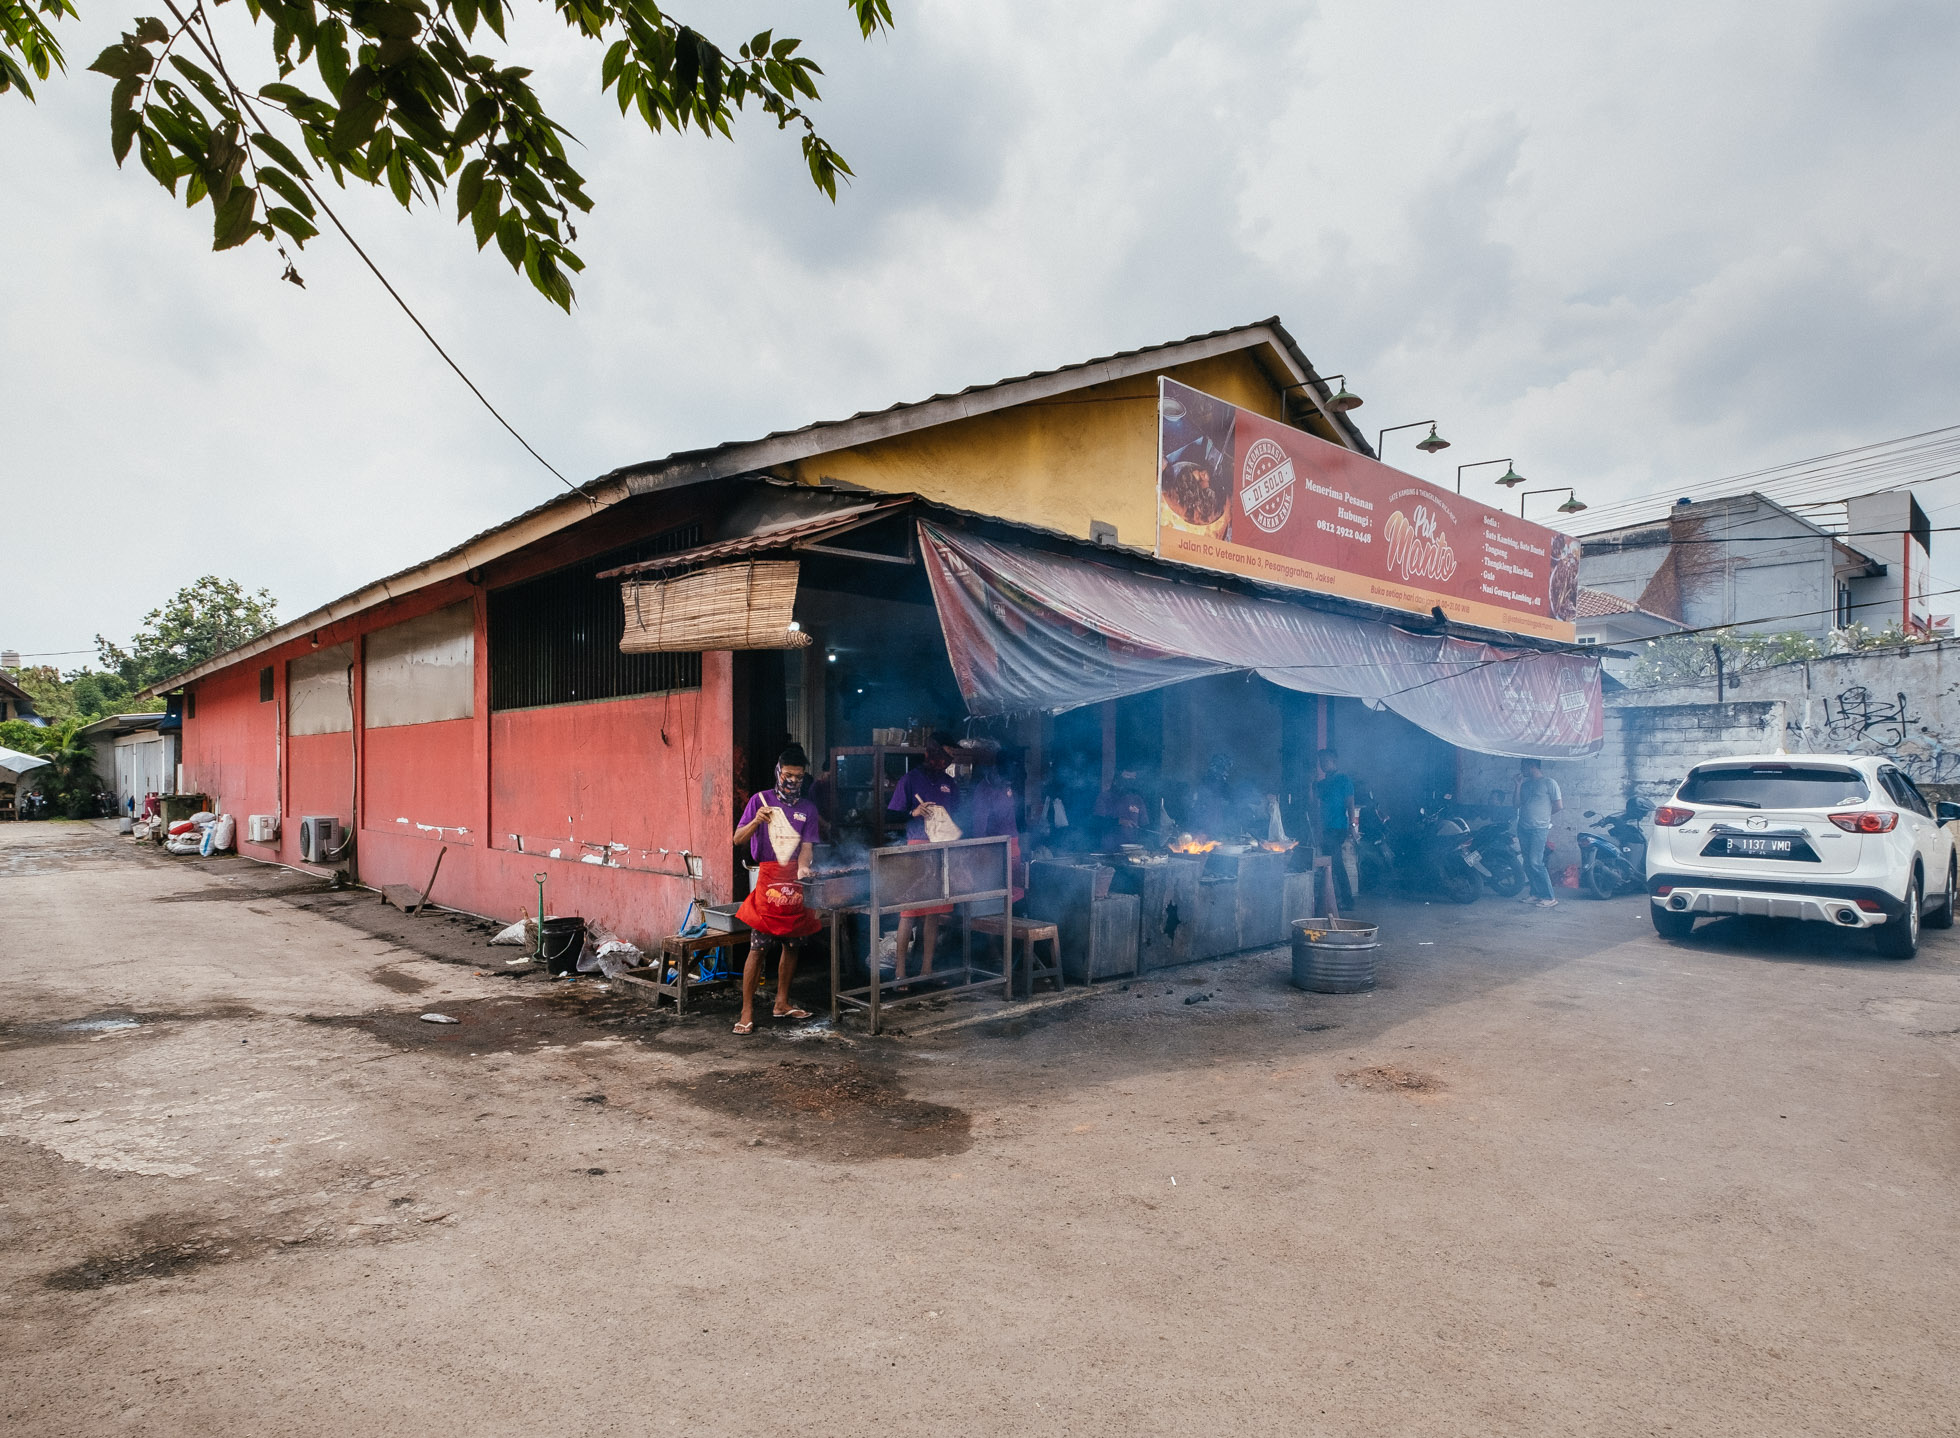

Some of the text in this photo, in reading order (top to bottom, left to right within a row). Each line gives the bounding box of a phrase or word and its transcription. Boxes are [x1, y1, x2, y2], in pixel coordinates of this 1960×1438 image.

[1246, 443, 1281, 481] REKOMENDASI
[1252, 470, 1284, 502] DI SOLO
[1305, 478, 1374, 511] Menerima Pesanan
[1257, 493, 1292, 528] MAKAN ENAK
[1337, 506, 1369, 528] Hubungi
[1413, 504, 1437, 544] Pak
[1316, 519, 1372, 544] 0812 2922 0448
[1485, 529, 1497, 541] Sate
[1519, 541, 1530, 552] Sate
[1384, 510, 1457, 582] Manto
[1178, 539, 1202, 553] Jalan
[1203, 544, 1214, 556] RC
[1215, 547, 1245, 564] Veteran
[1246, 554, 1257, 566] No
[1264, 559, 1314, 582] Pesanggrahan,
[1315, 571, 1336, 585] Jaksel
[1483, 570, 1496, 581] Gule
[1370, 585, 1384, 596] Buka
[1385, 588, 1403, 602] setiap
[1482, 583, 1494, 595] Nasi
[1494, 586, 1512, 601] Goreng
[1726, 838, 1733, 849] B
[1742, 839, 1766, 850] 1137
